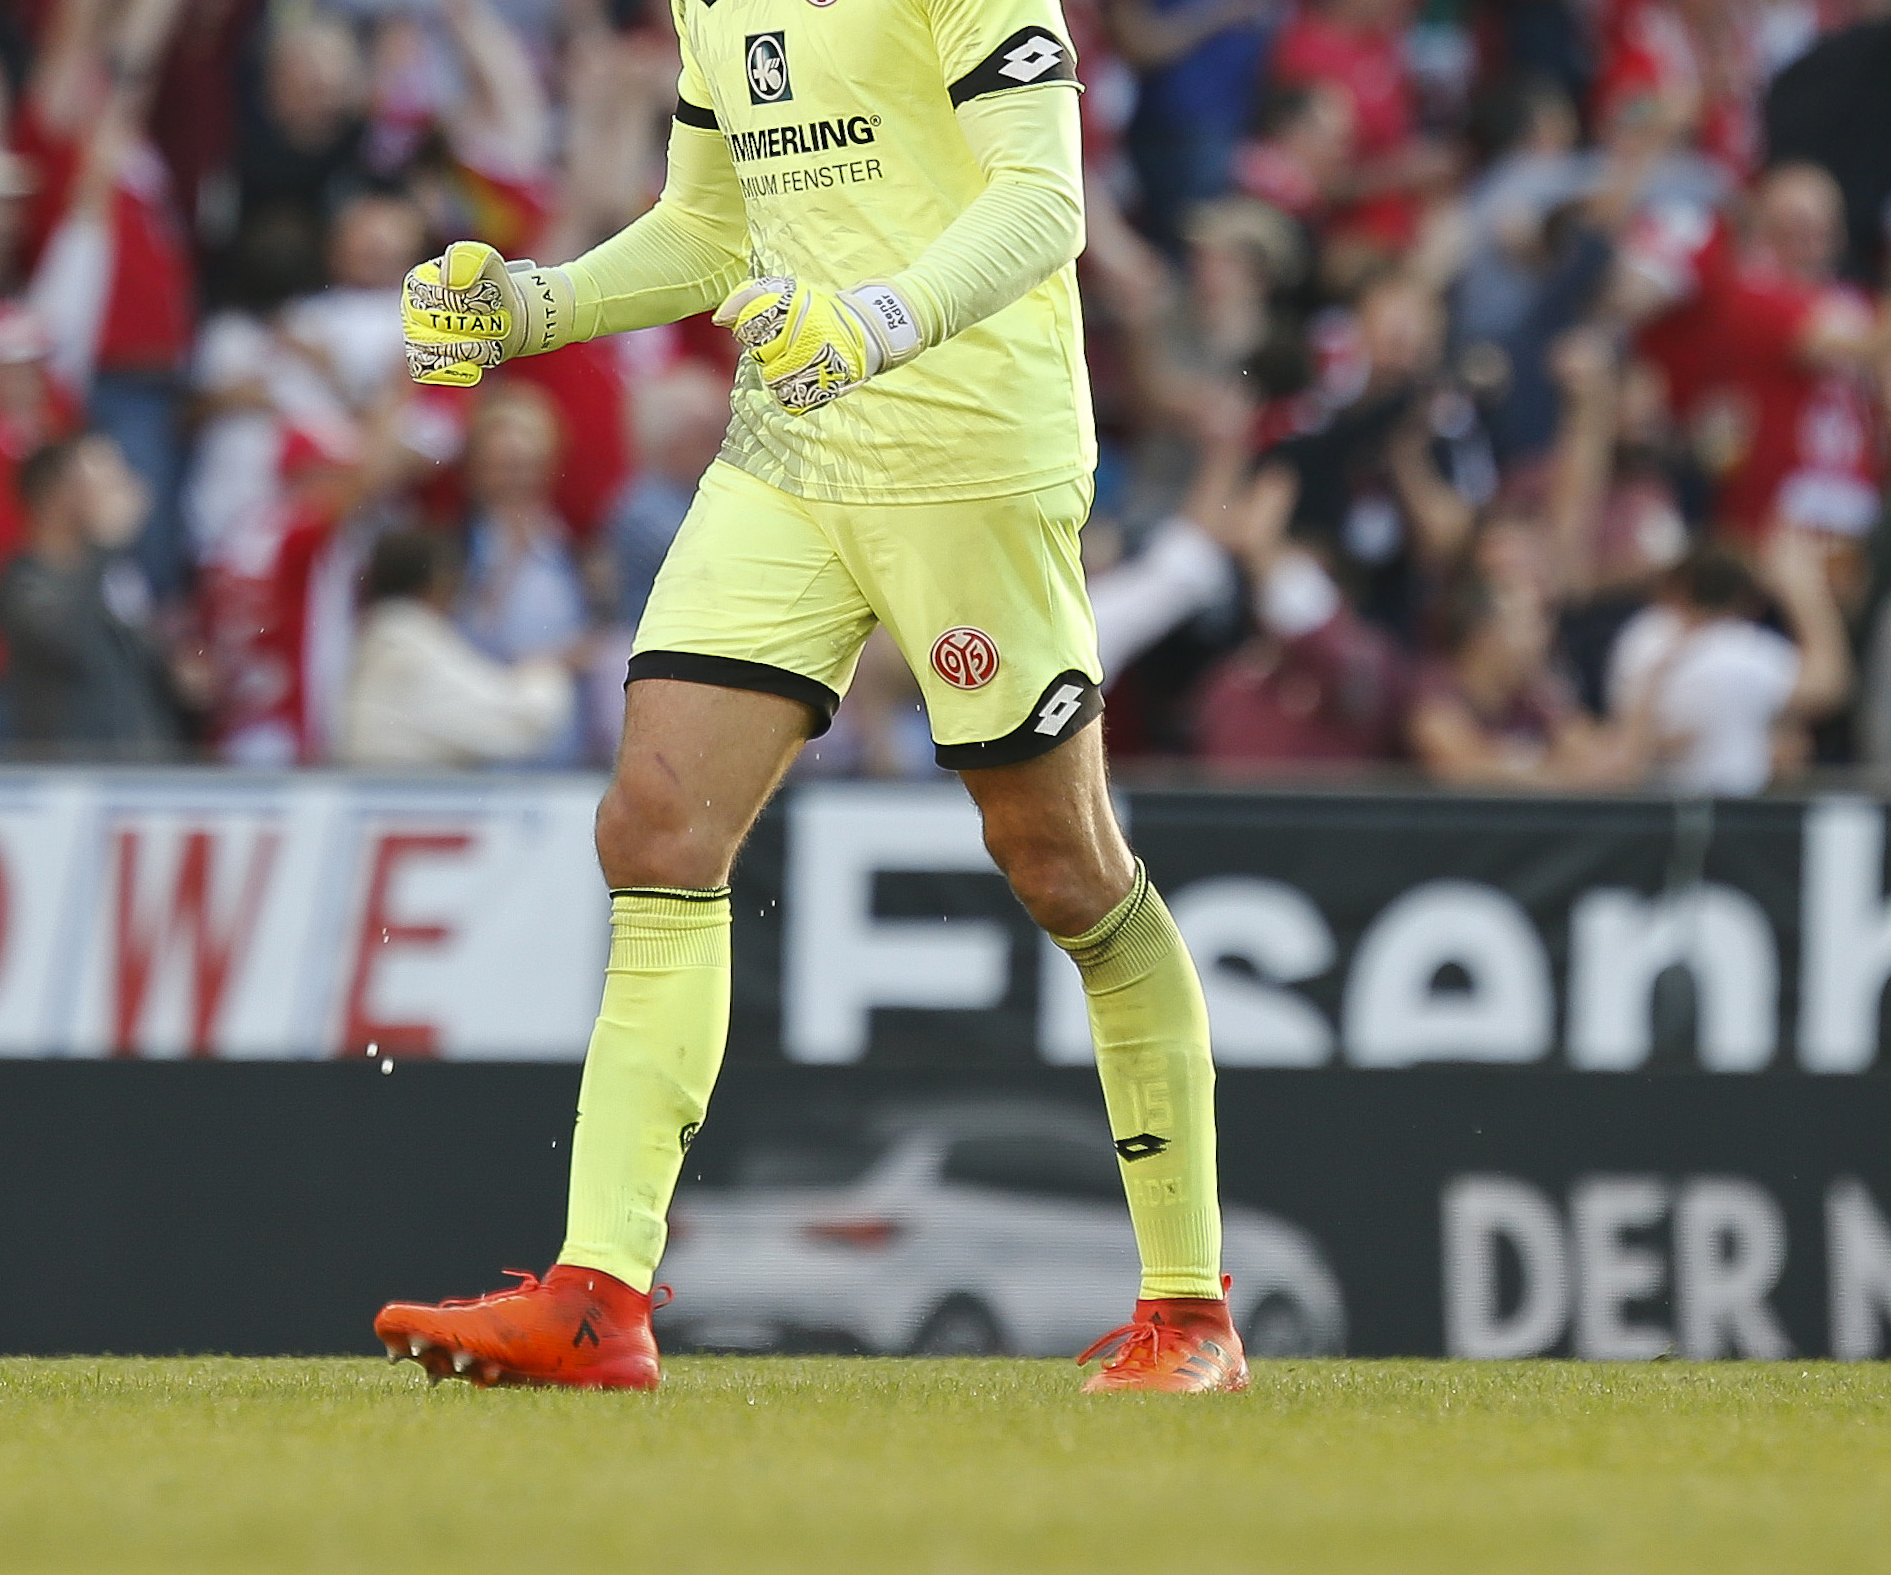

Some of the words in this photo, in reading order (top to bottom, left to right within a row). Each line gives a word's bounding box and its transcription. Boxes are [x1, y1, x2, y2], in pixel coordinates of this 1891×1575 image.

[726, 116, 875, 163] MMERLING
[783, 158, 883, 193] FENSTER
[881, 294, 908, 325] Adler
[1439, 1173, 1798, 1363] DER
